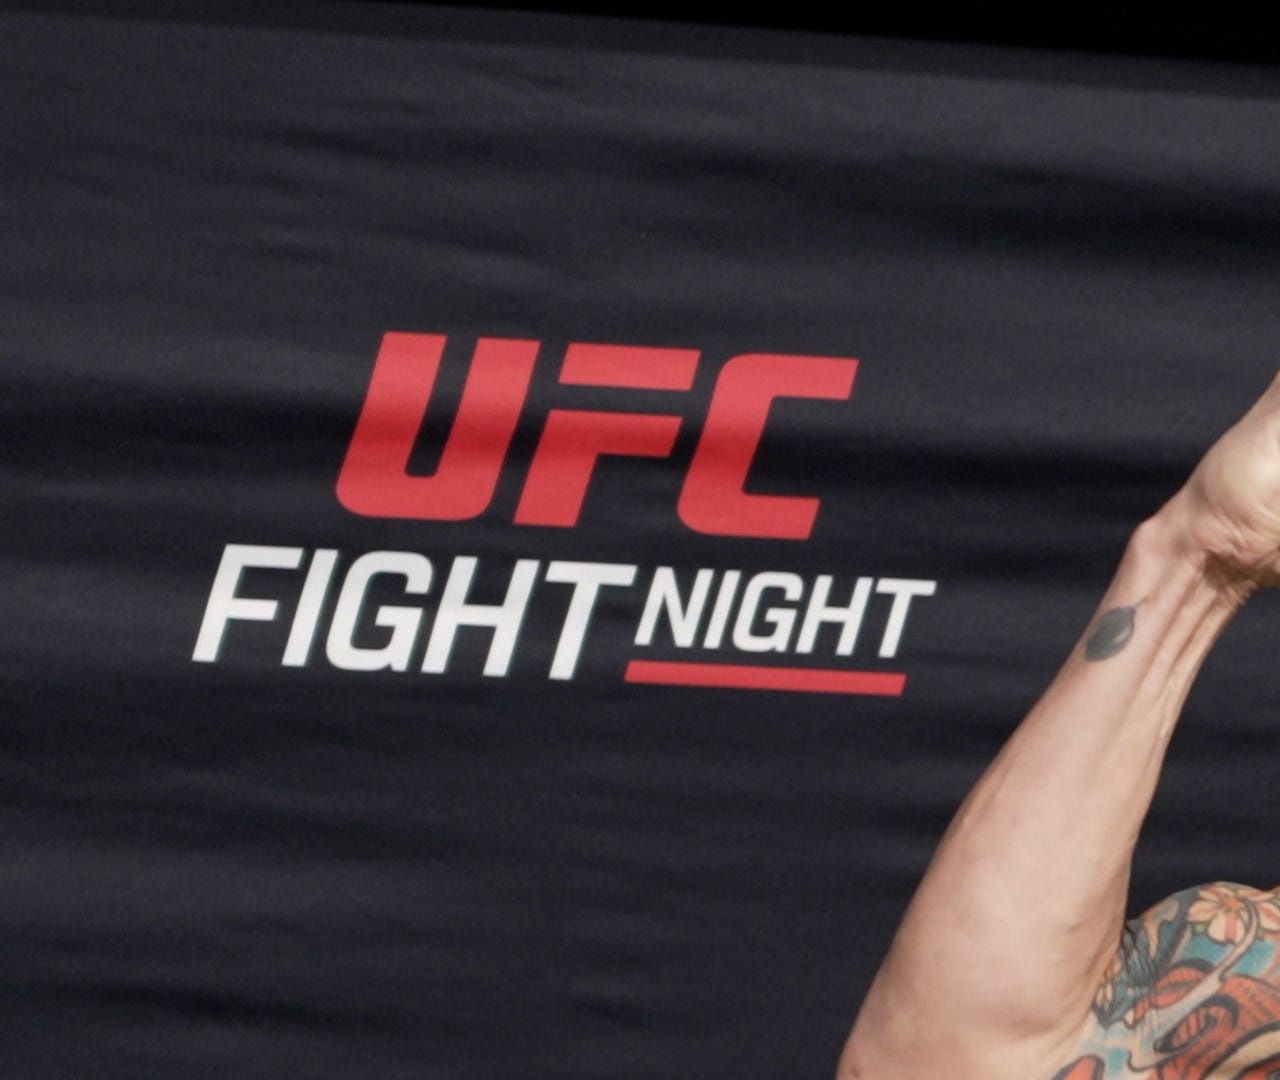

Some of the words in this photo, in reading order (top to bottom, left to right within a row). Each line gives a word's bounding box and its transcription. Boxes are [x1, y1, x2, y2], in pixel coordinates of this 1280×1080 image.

[335, 331, 860, 540] UFC
[192, 543, 638, 681] FIGHT
[633, 566, 937, 659] NIGHT
